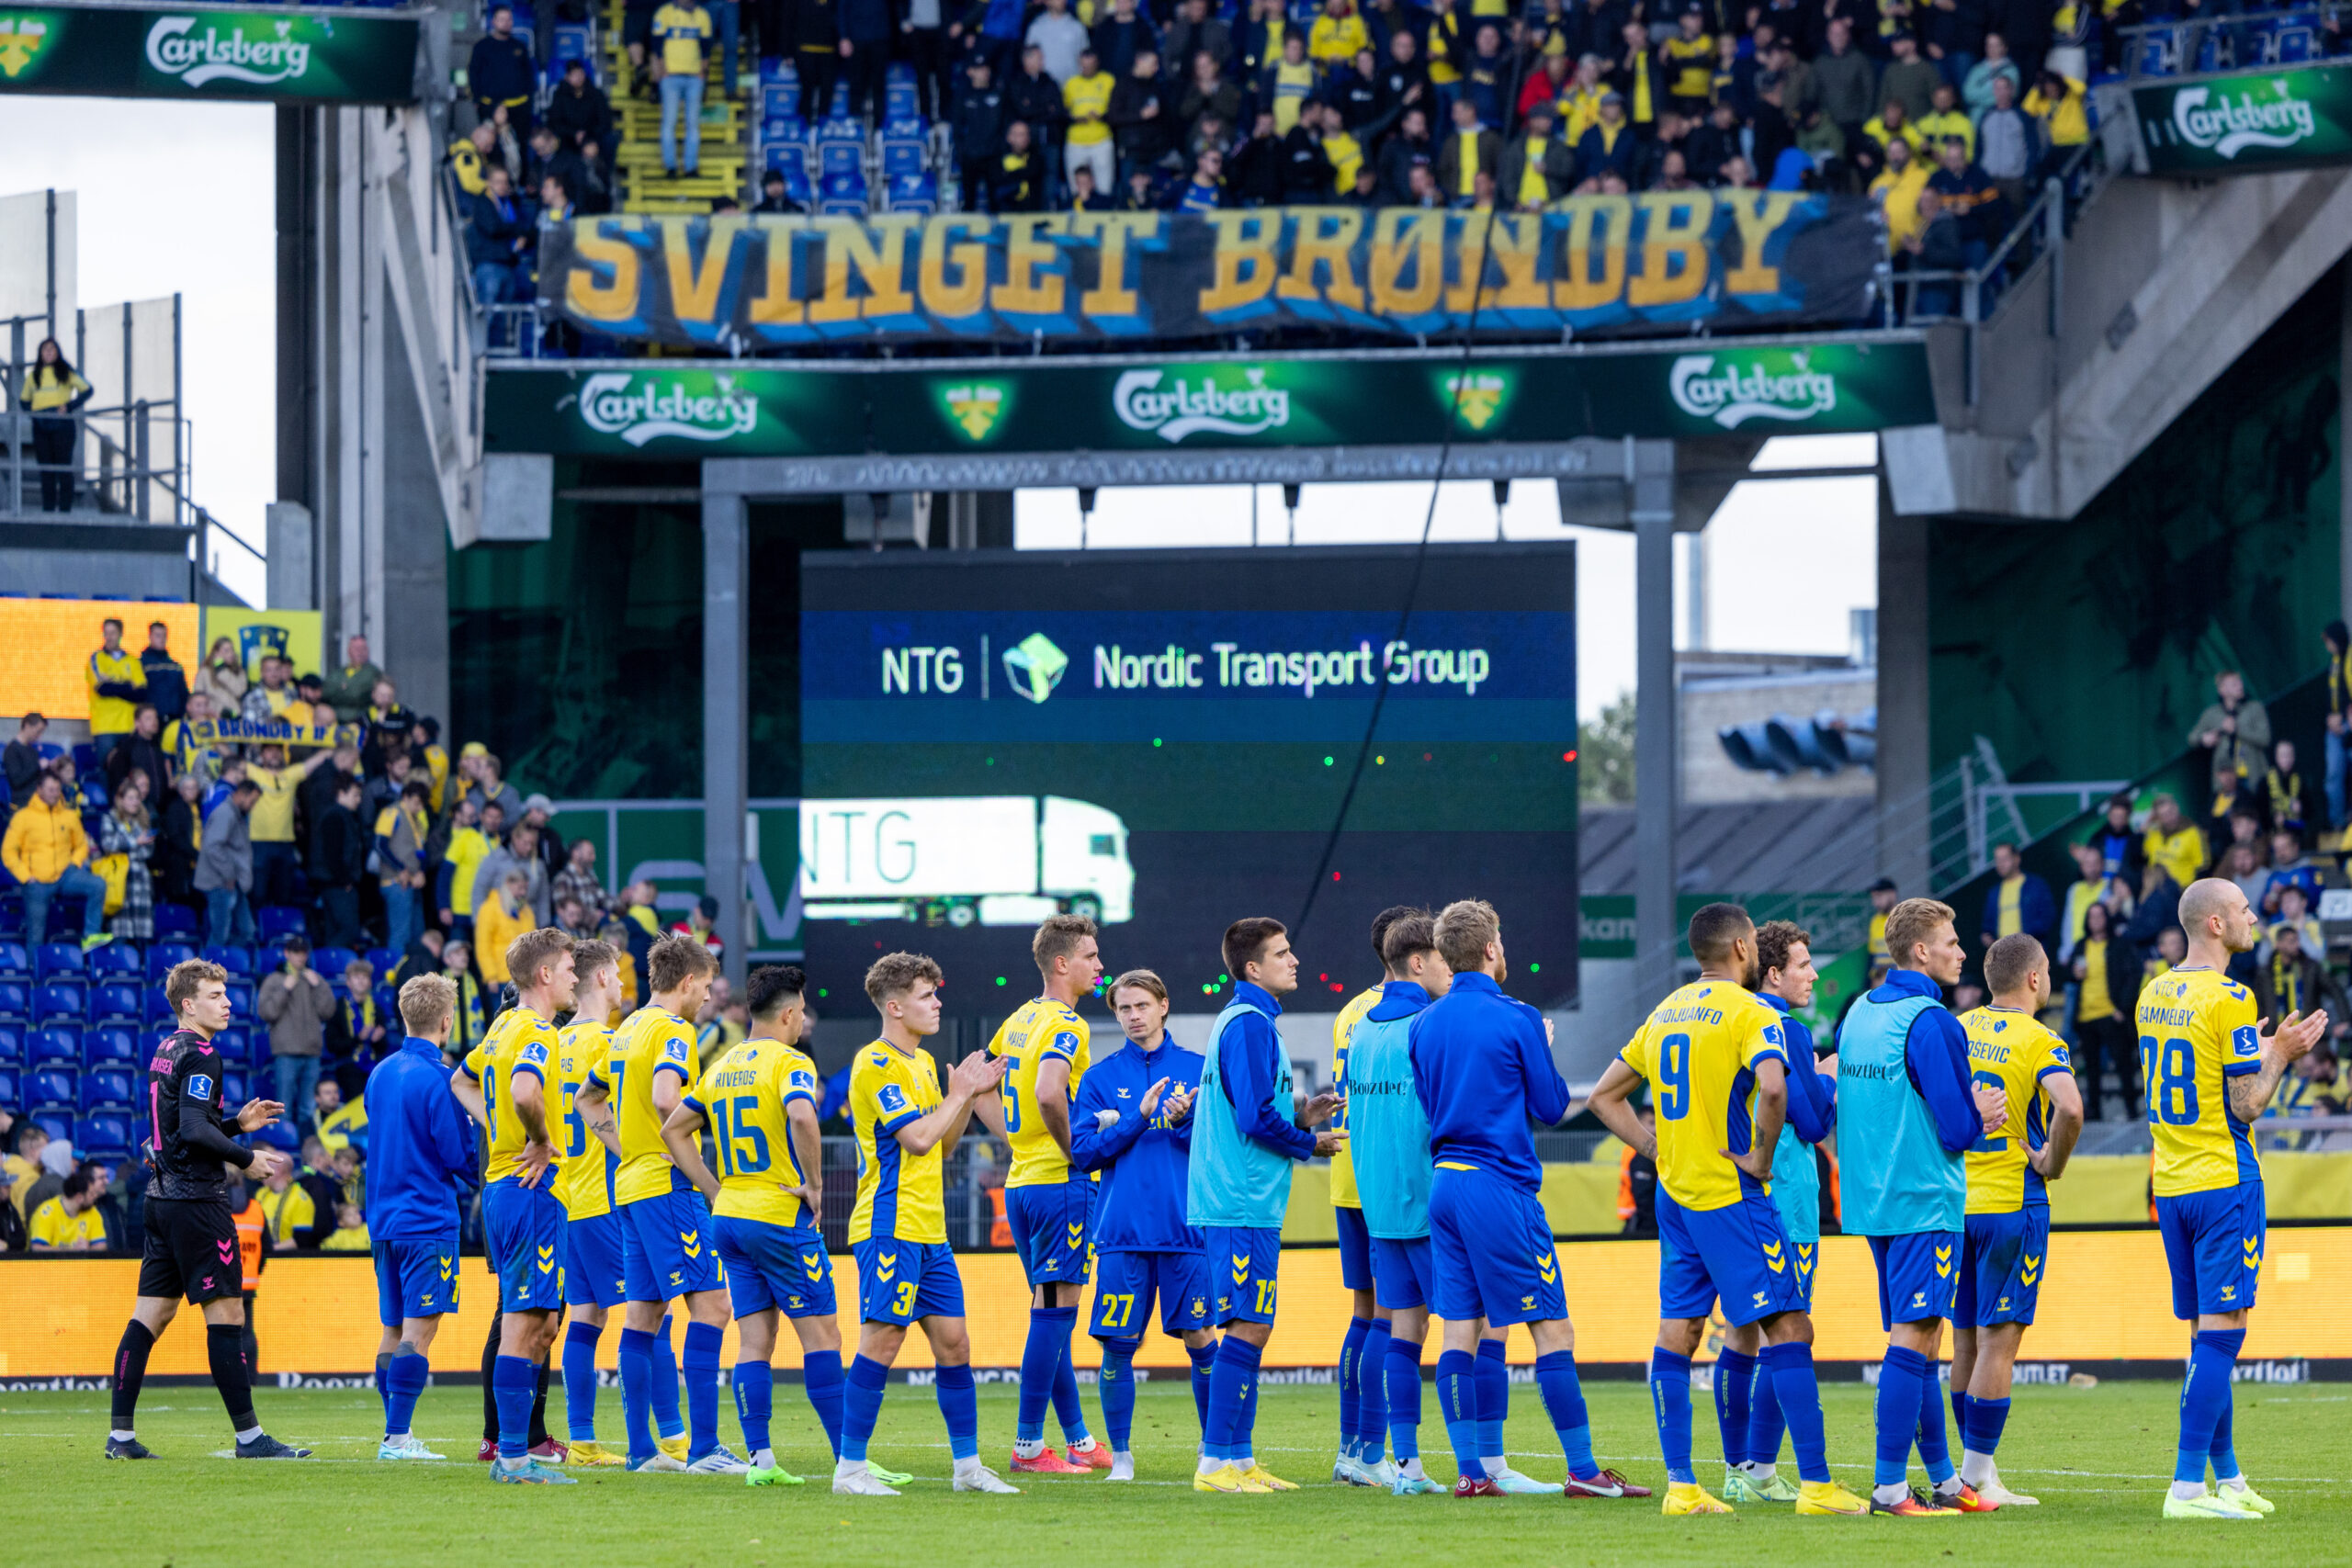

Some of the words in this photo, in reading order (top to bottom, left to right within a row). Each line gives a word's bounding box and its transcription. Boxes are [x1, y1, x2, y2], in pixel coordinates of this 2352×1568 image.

[146, 17, 310, 87] Carlsberg
[2174, 86, 2314, 159] Carlsberg
[565, 211, 1159, 331] SVINGET
[1198, 190, 1810, 321] BRØNDBY
[580, 374, 758, 446] Carlsberg
[1114, 370, 1288, 443] Carlsberg
[1670, 355, 1835, 429] Carlsberg
[881, 646, 964, 694] NTG
[1094, 645, 1203, 688] Nordic
[1211, 639, 1374, 699] Transport
[1383, 640, 1490, 695] Group
[1966, 1013, 1991, 1032] NTG
[2139, 1006, 2195, 1027] GAMMELBY
[2153, 980, 2175, 996] NTG
[609, 1060, 626, 1137] 7
[715, 1070, 757, 1089] RIVEROS
[1002, 1055, 1022, 1134] 5
[1659, 1032, 1690, 1121] 9
[2139, 1035, 2200, 1126] 28
[150, 1080, 163, 1150] 1
[562, 1082, 586, 1157] 3
[712, 1095, 772, 1176] 15
[1101, 1293, 1135, 1327] 27
[1255, 1279, 1276, 1314] 12
